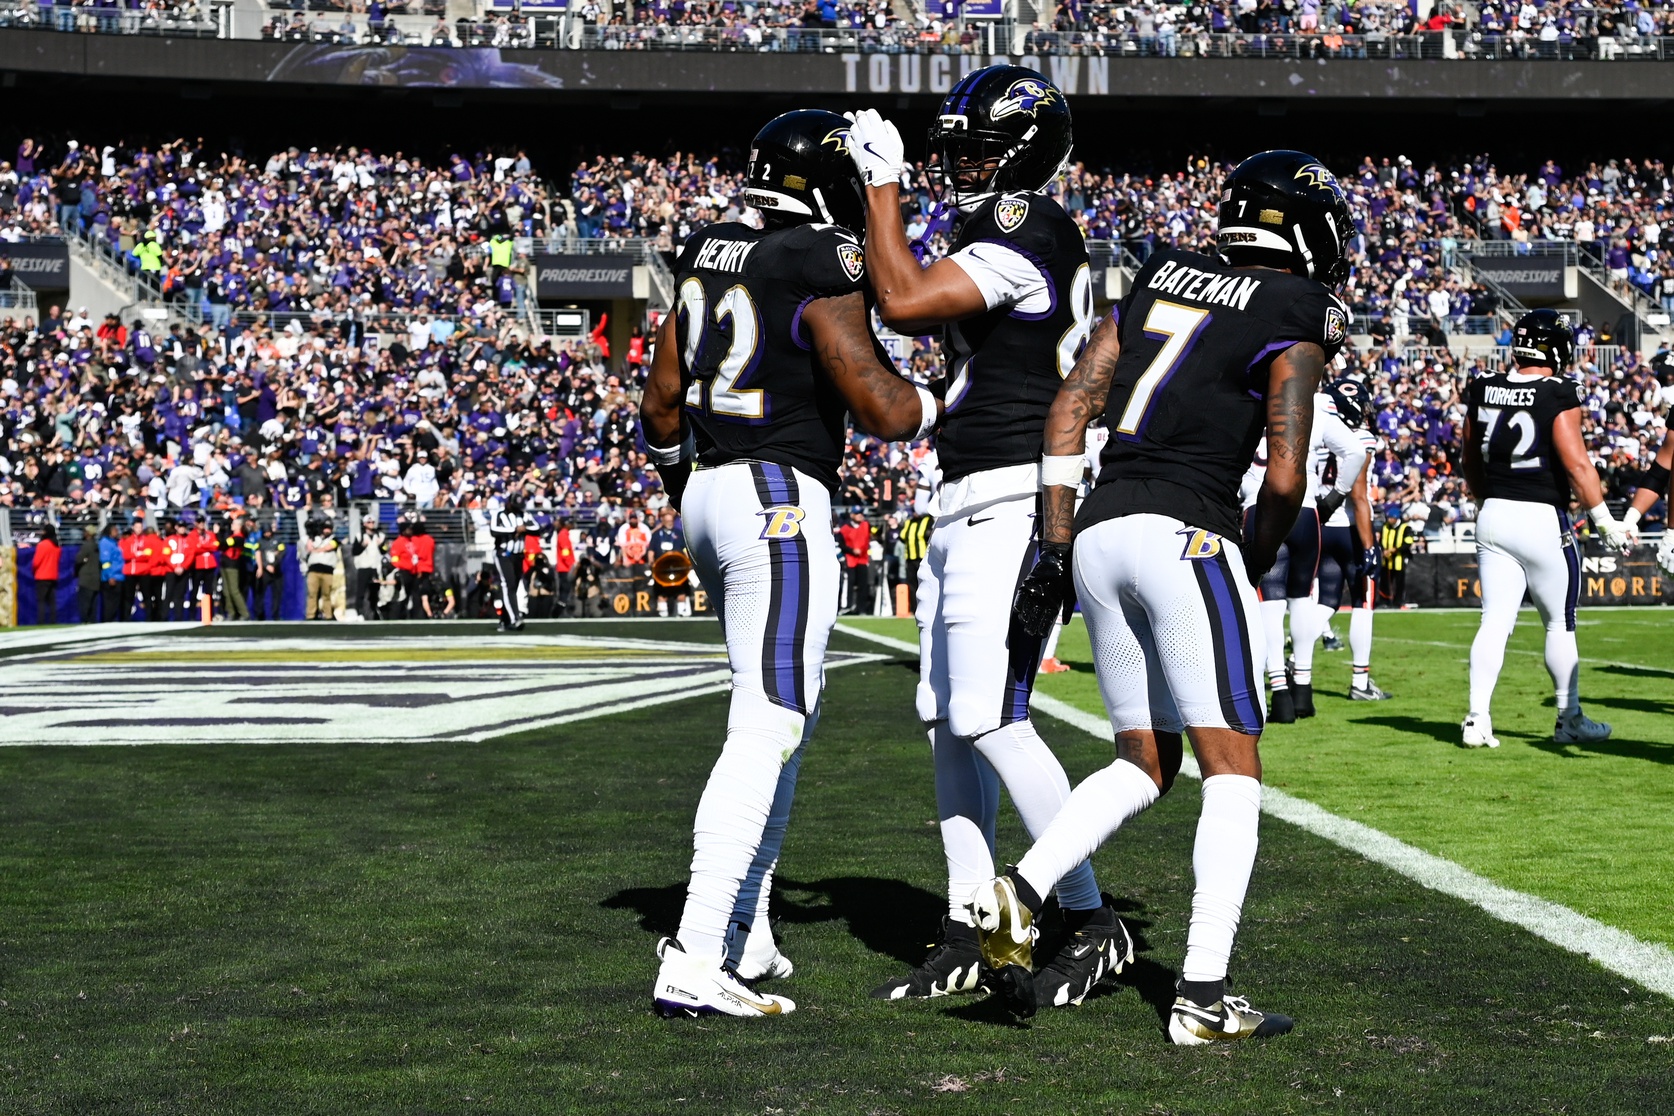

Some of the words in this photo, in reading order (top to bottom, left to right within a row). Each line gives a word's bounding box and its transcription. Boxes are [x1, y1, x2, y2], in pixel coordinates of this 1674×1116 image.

[1238, 200, 1248, 218] 7
[693, 237, 759, 273] HENRY
[539, 268, 630, 283] PROGRESSIVE
[1147, 260, 1262, 311] BATEMAN
[677, 276, 769, 424] 22
[1116, 298, 1212, 440] 7
[1484, 385, 1537, 407] VORHEES
[1477, 406, 1543, 472] 72
[755, 504, 806, 540] B
